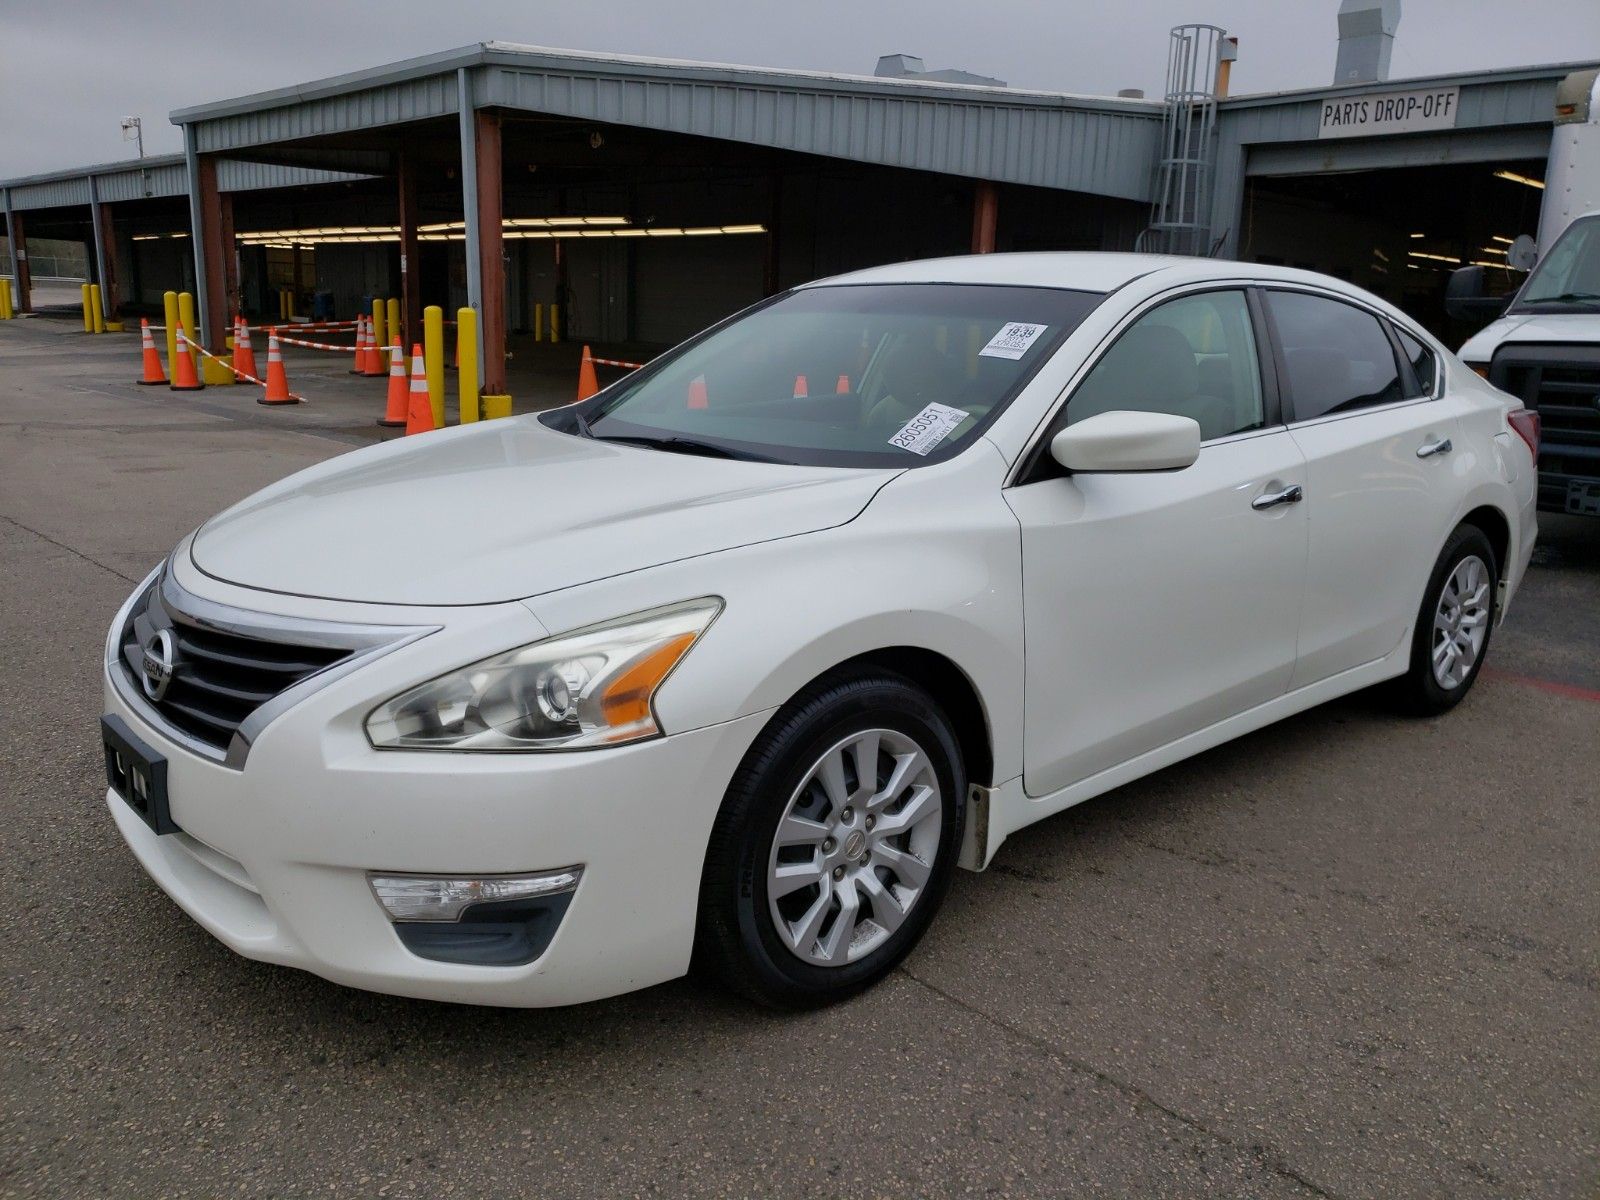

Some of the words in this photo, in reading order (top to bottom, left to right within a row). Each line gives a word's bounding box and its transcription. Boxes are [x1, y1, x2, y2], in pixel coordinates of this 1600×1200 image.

[1323, 101, 1369, 126] PARTS
[1374, 93, 1455, 122] DROP-OFF
[893, 408, 943, 448] 2605051
